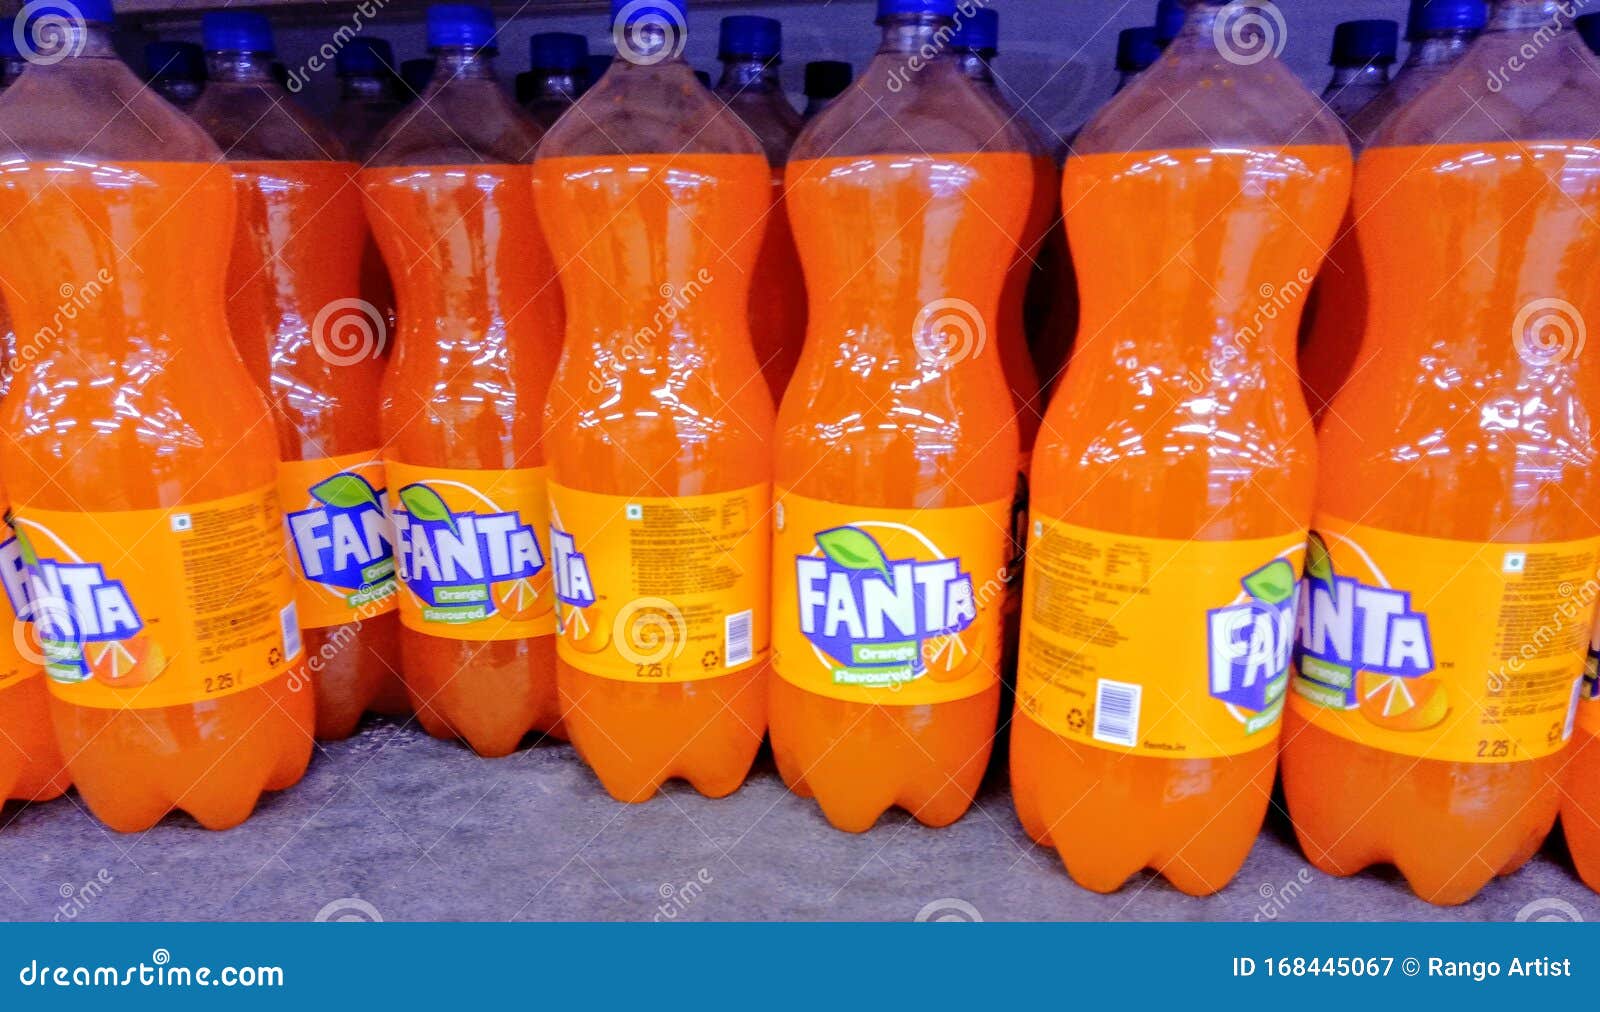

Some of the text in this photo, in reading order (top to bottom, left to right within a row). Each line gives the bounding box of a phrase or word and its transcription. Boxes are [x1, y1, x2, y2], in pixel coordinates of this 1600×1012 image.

[439, 589, 485, 602] Orange
[797, 557, 976, 639] FANTA
[424, 607, 485, 621] Flavoured
[858, 646, 915, 663] Orange
[834, 668, 912, 684] Flavoured
